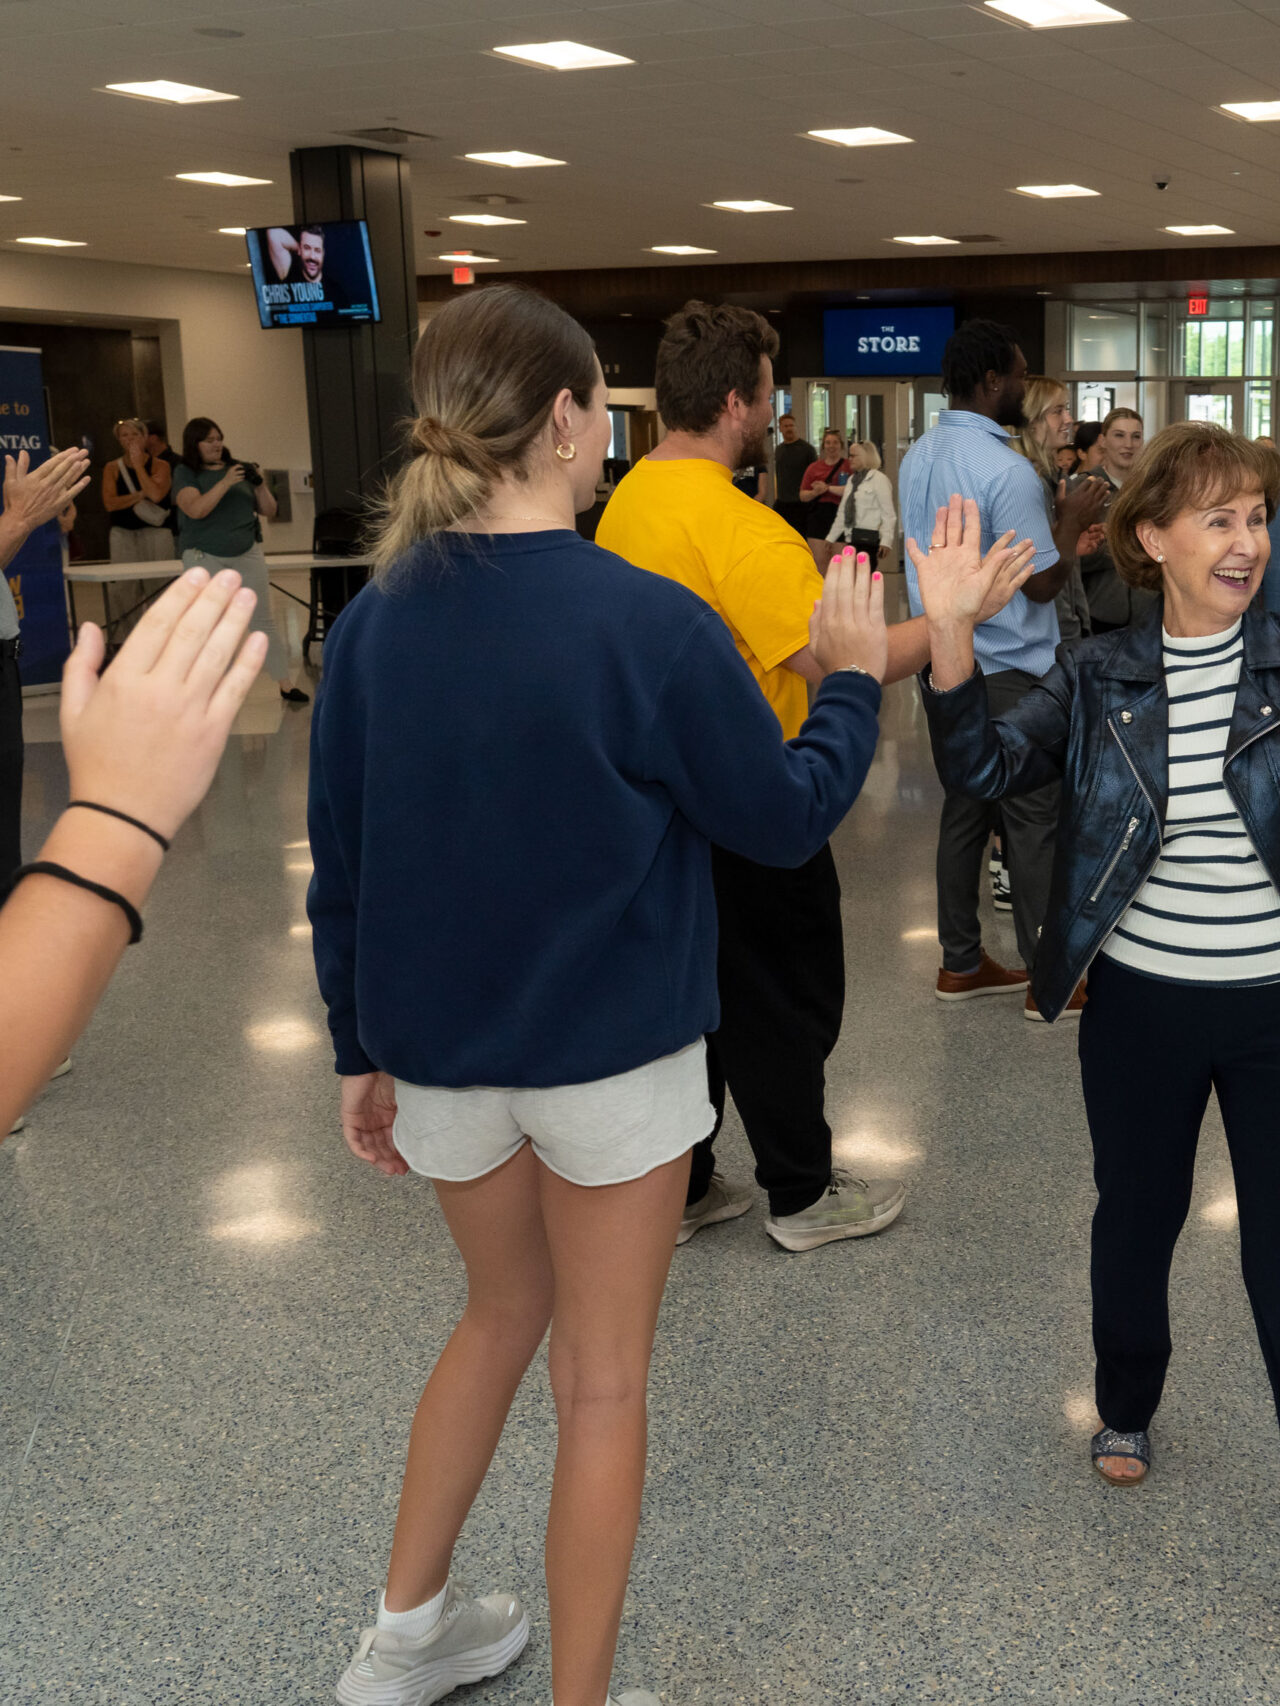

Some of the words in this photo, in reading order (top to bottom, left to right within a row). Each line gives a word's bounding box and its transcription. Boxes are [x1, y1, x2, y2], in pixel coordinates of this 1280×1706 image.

[262, 284, 291, 304] CHRIS
[291, 282, 325, 302] YOUNG
[1188, 299, 1208, 315] EXIT
[857, 336, 921, 353] STORE
[13, 401, 30, 416] to
